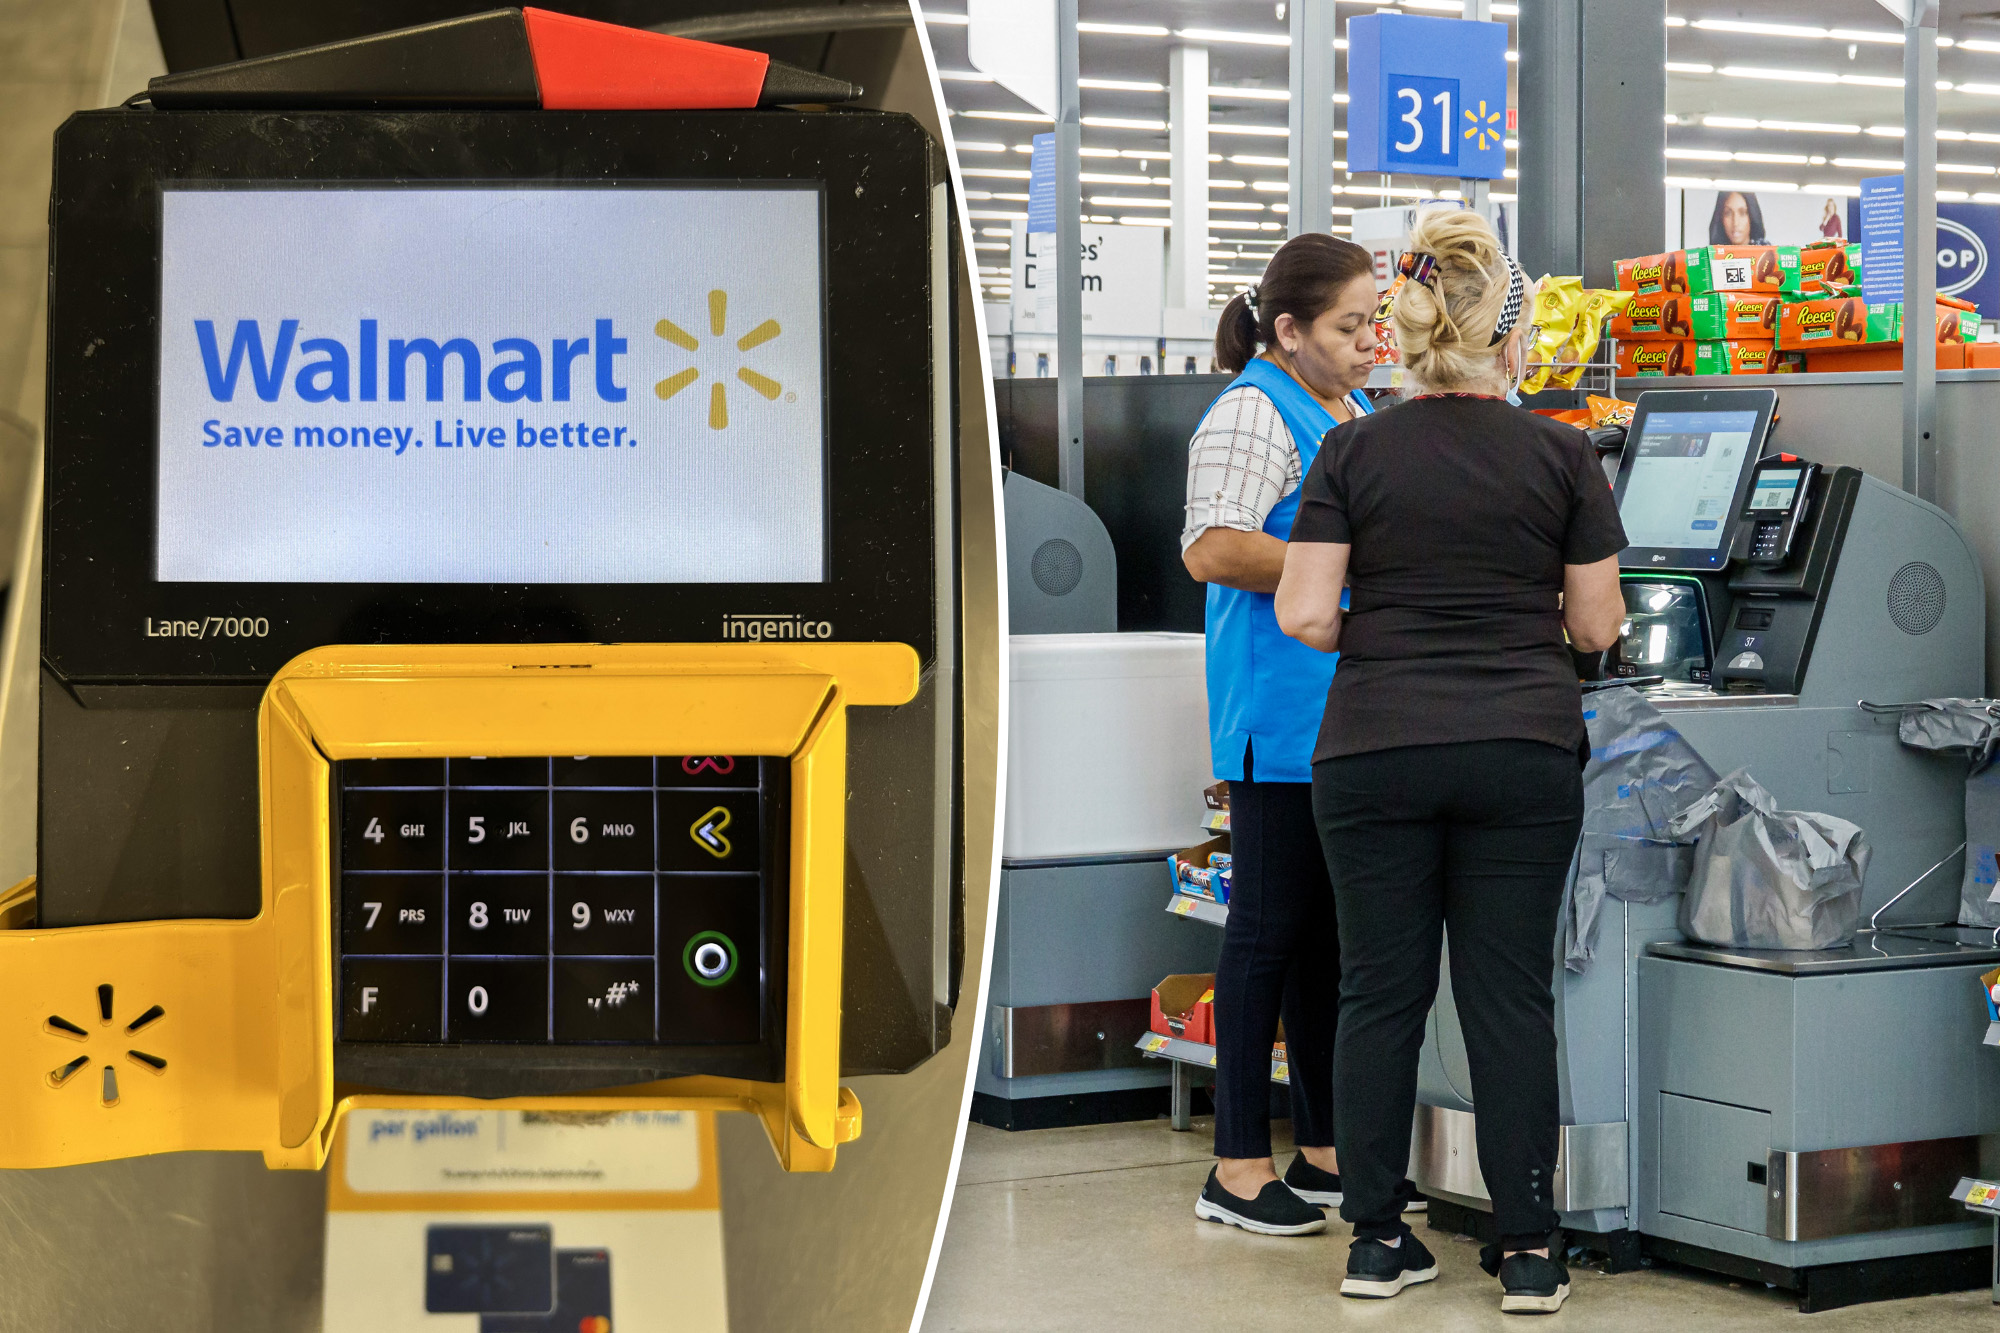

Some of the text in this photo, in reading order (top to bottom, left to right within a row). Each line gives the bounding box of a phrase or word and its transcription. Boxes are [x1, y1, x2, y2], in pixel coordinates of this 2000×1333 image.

[1395, 87, 1451, 155] 31
[1801, 261, 1826, 273] eese's
[1937, 248, 1975, 269] OP
[1631, 262, 1662, 281] Reese's
[1626, 299, 1660, 318] Reese's
[1693, 304, 1709, 312] SIZE
[1733, 299, 1764, 313] Reese's
[1797, 305, 1837, 326] Reese's
[1961, 327, 1977, 336] SIZE
[1962, 320, 1978, 329] KING
[193, 318, 628, 404] Walmart
[1632, 345, 1667, 364] Reese's
[1698, 350, 1712, 358] SIZE
[1736, 346, 1767, 360] Reese's
[202, 418, 638, 457] Save money. Live better.
[146, 615, 270, 640] Lane/7000
[722, 613, 833, 643] ingenico
[1744, 636, 1756, 648] 37
[363, 816, 426, 844] 4 GHI
[468, 816, 531, 844] 5 JKL
[569, 816, 635, 844] 6 MNO
[362, 901, 426, 929] 7 PRS
[468, 901, 531, 929] 8 TUV
[571, 901, 636, 929] 9 WXY
[361, 986, 379, 1014] F
[467, 985, 489, 1014] 0
